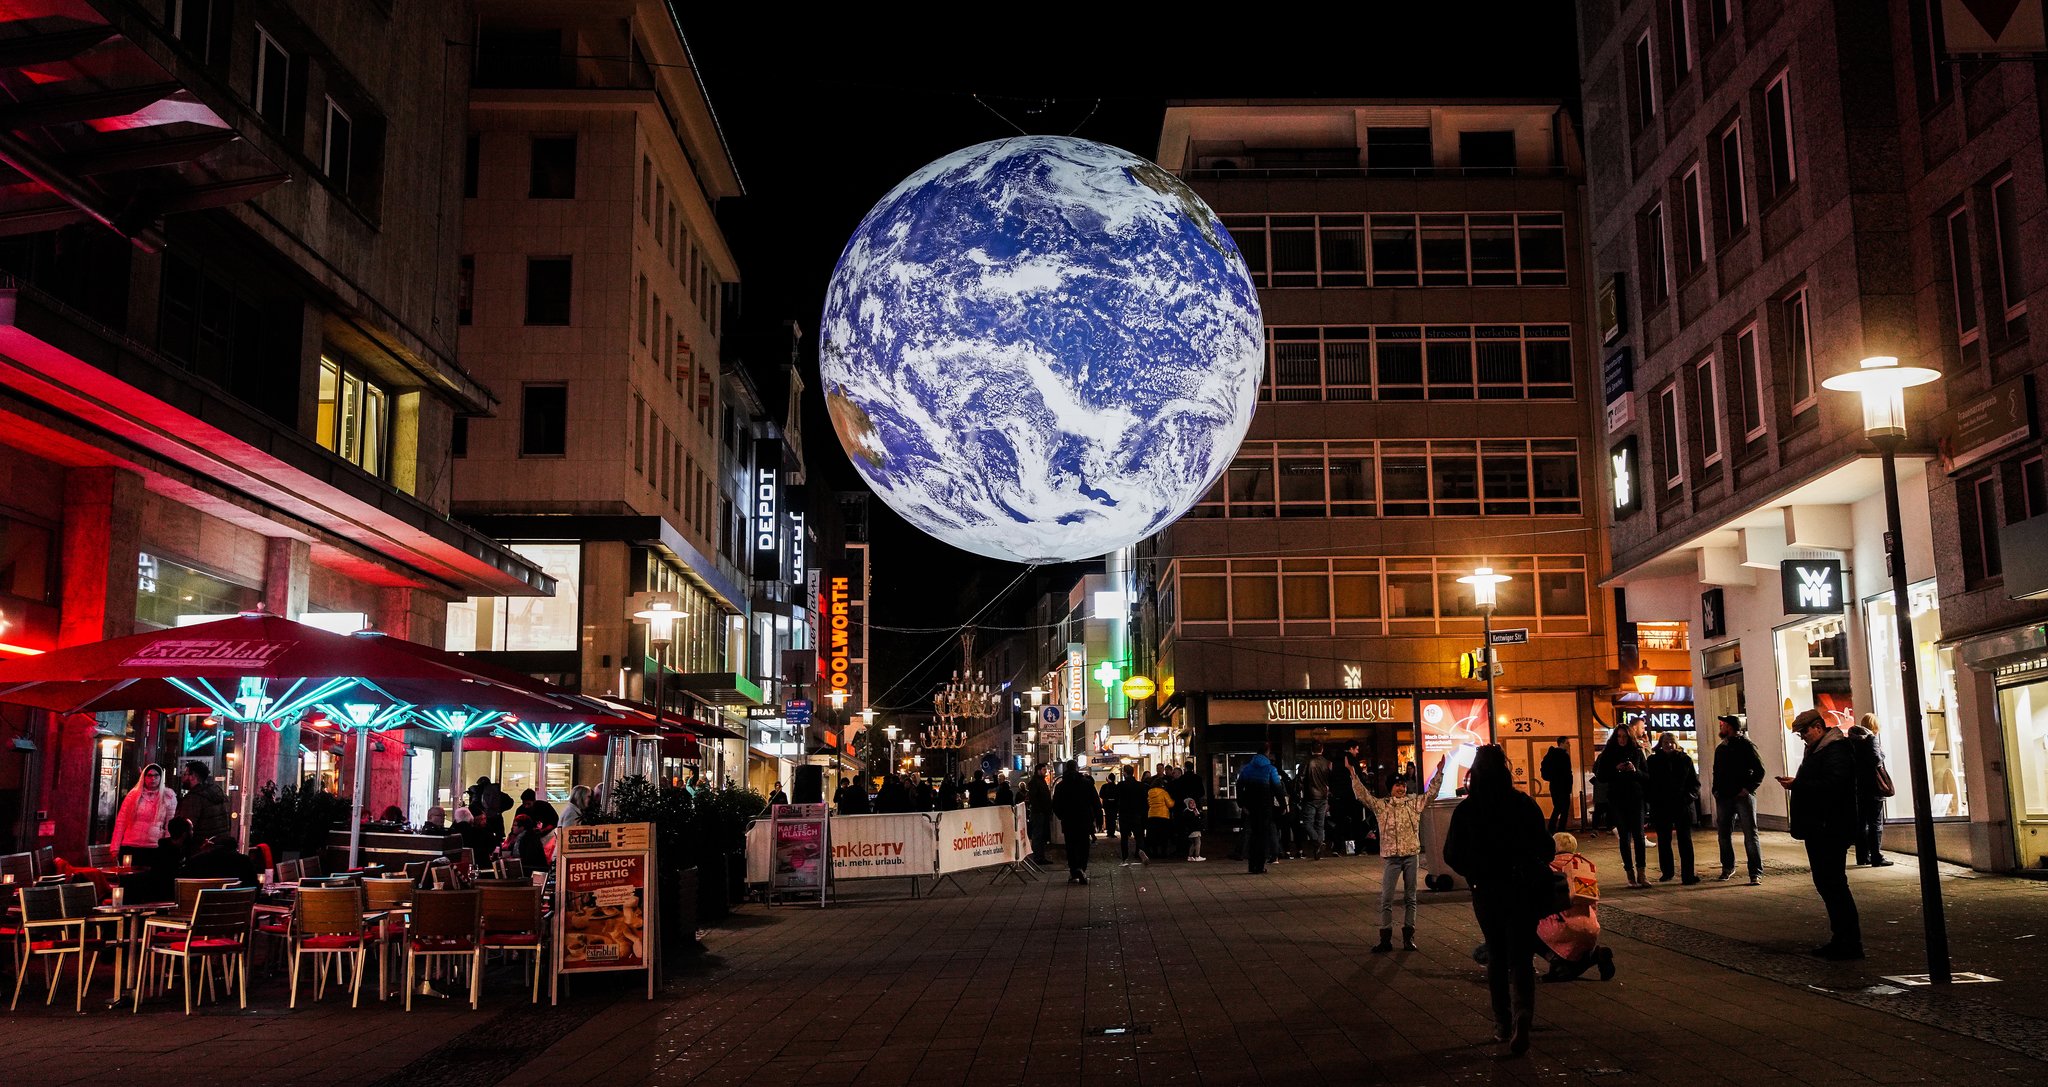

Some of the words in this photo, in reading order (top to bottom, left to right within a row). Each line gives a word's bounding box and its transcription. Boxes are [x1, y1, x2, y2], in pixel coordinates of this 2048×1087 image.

[758, 468, 776, 550] DEPOT
[1795, 566, 1832, 607] WMF
[1492, 634, 1514, 643] Kettwiger
[1514, 633, 1523, 641] Str.
[1070, 652, 1082, 712] böhmer
[751, 708, 775, 716] BRAX
[1267, 698, 1344, 721] Schlemme
[1348, 698, 1394, 722] meyer
[1515, 722, 1532, 733] 23
[1683, 713, 1695, 728] &
[778, 823, 811, 832] KAFFEE-
[782, 829, 818, 838] KLATSCH
[569, 829, 612, 844] extrablatt
[953, 832, 1005, 852] sonnenklar.TV
[569, 858, 636, 873] FRÜHSTÜCK
[849, 858, 873, 867] mehr.
[875, 856, 905, 866] urlaub.
[569, 872, 588, 882] IST
[590, 868, 629, 881] FERTIG
